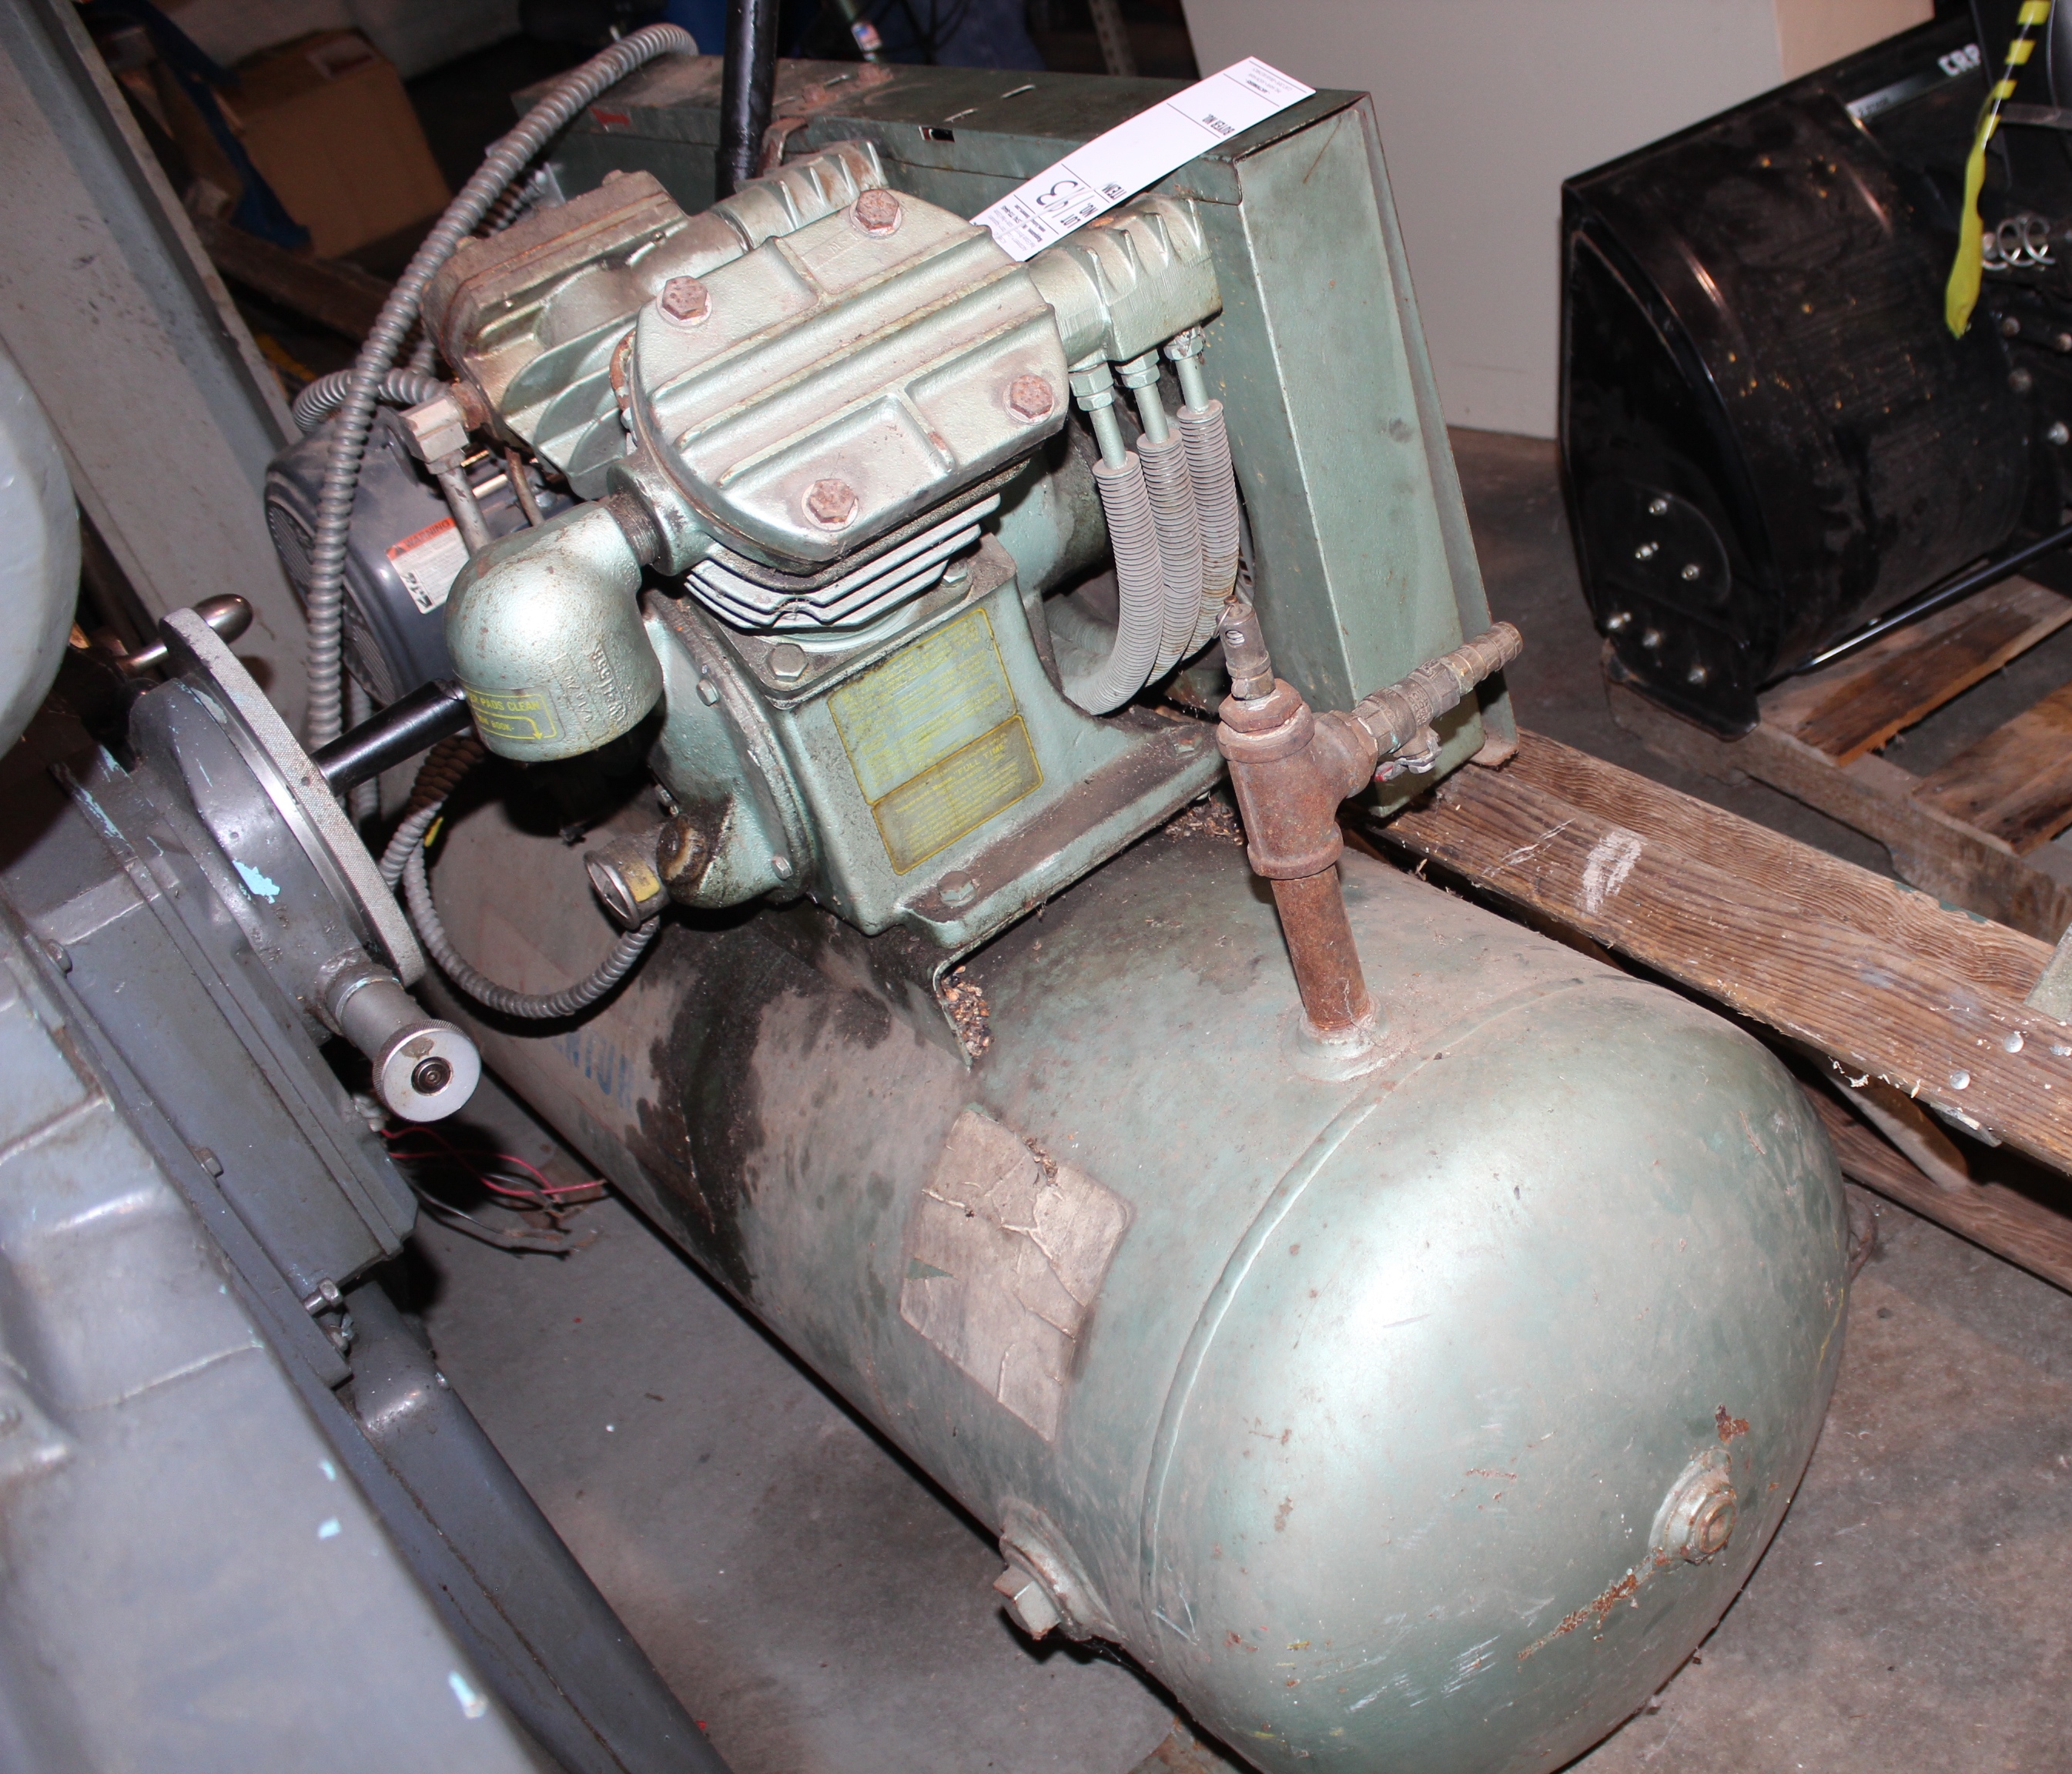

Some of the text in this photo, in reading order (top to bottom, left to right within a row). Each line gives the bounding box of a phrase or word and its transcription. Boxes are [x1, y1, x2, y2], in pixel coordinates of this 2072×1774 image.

[1203, 113, 1235, 136] BUYER NO.
[1036, 180, 1094, 219] 193
[1102, 183, 1127, 200] ITEM
[1080, 203, 1099, 218] NO.
[1060, 214, 1081, 229] LOT
[405, 520, 450, 547] WARNING
[480, 697, 504, 711] PADS
[507, 700, 541, 713] CLEAN
